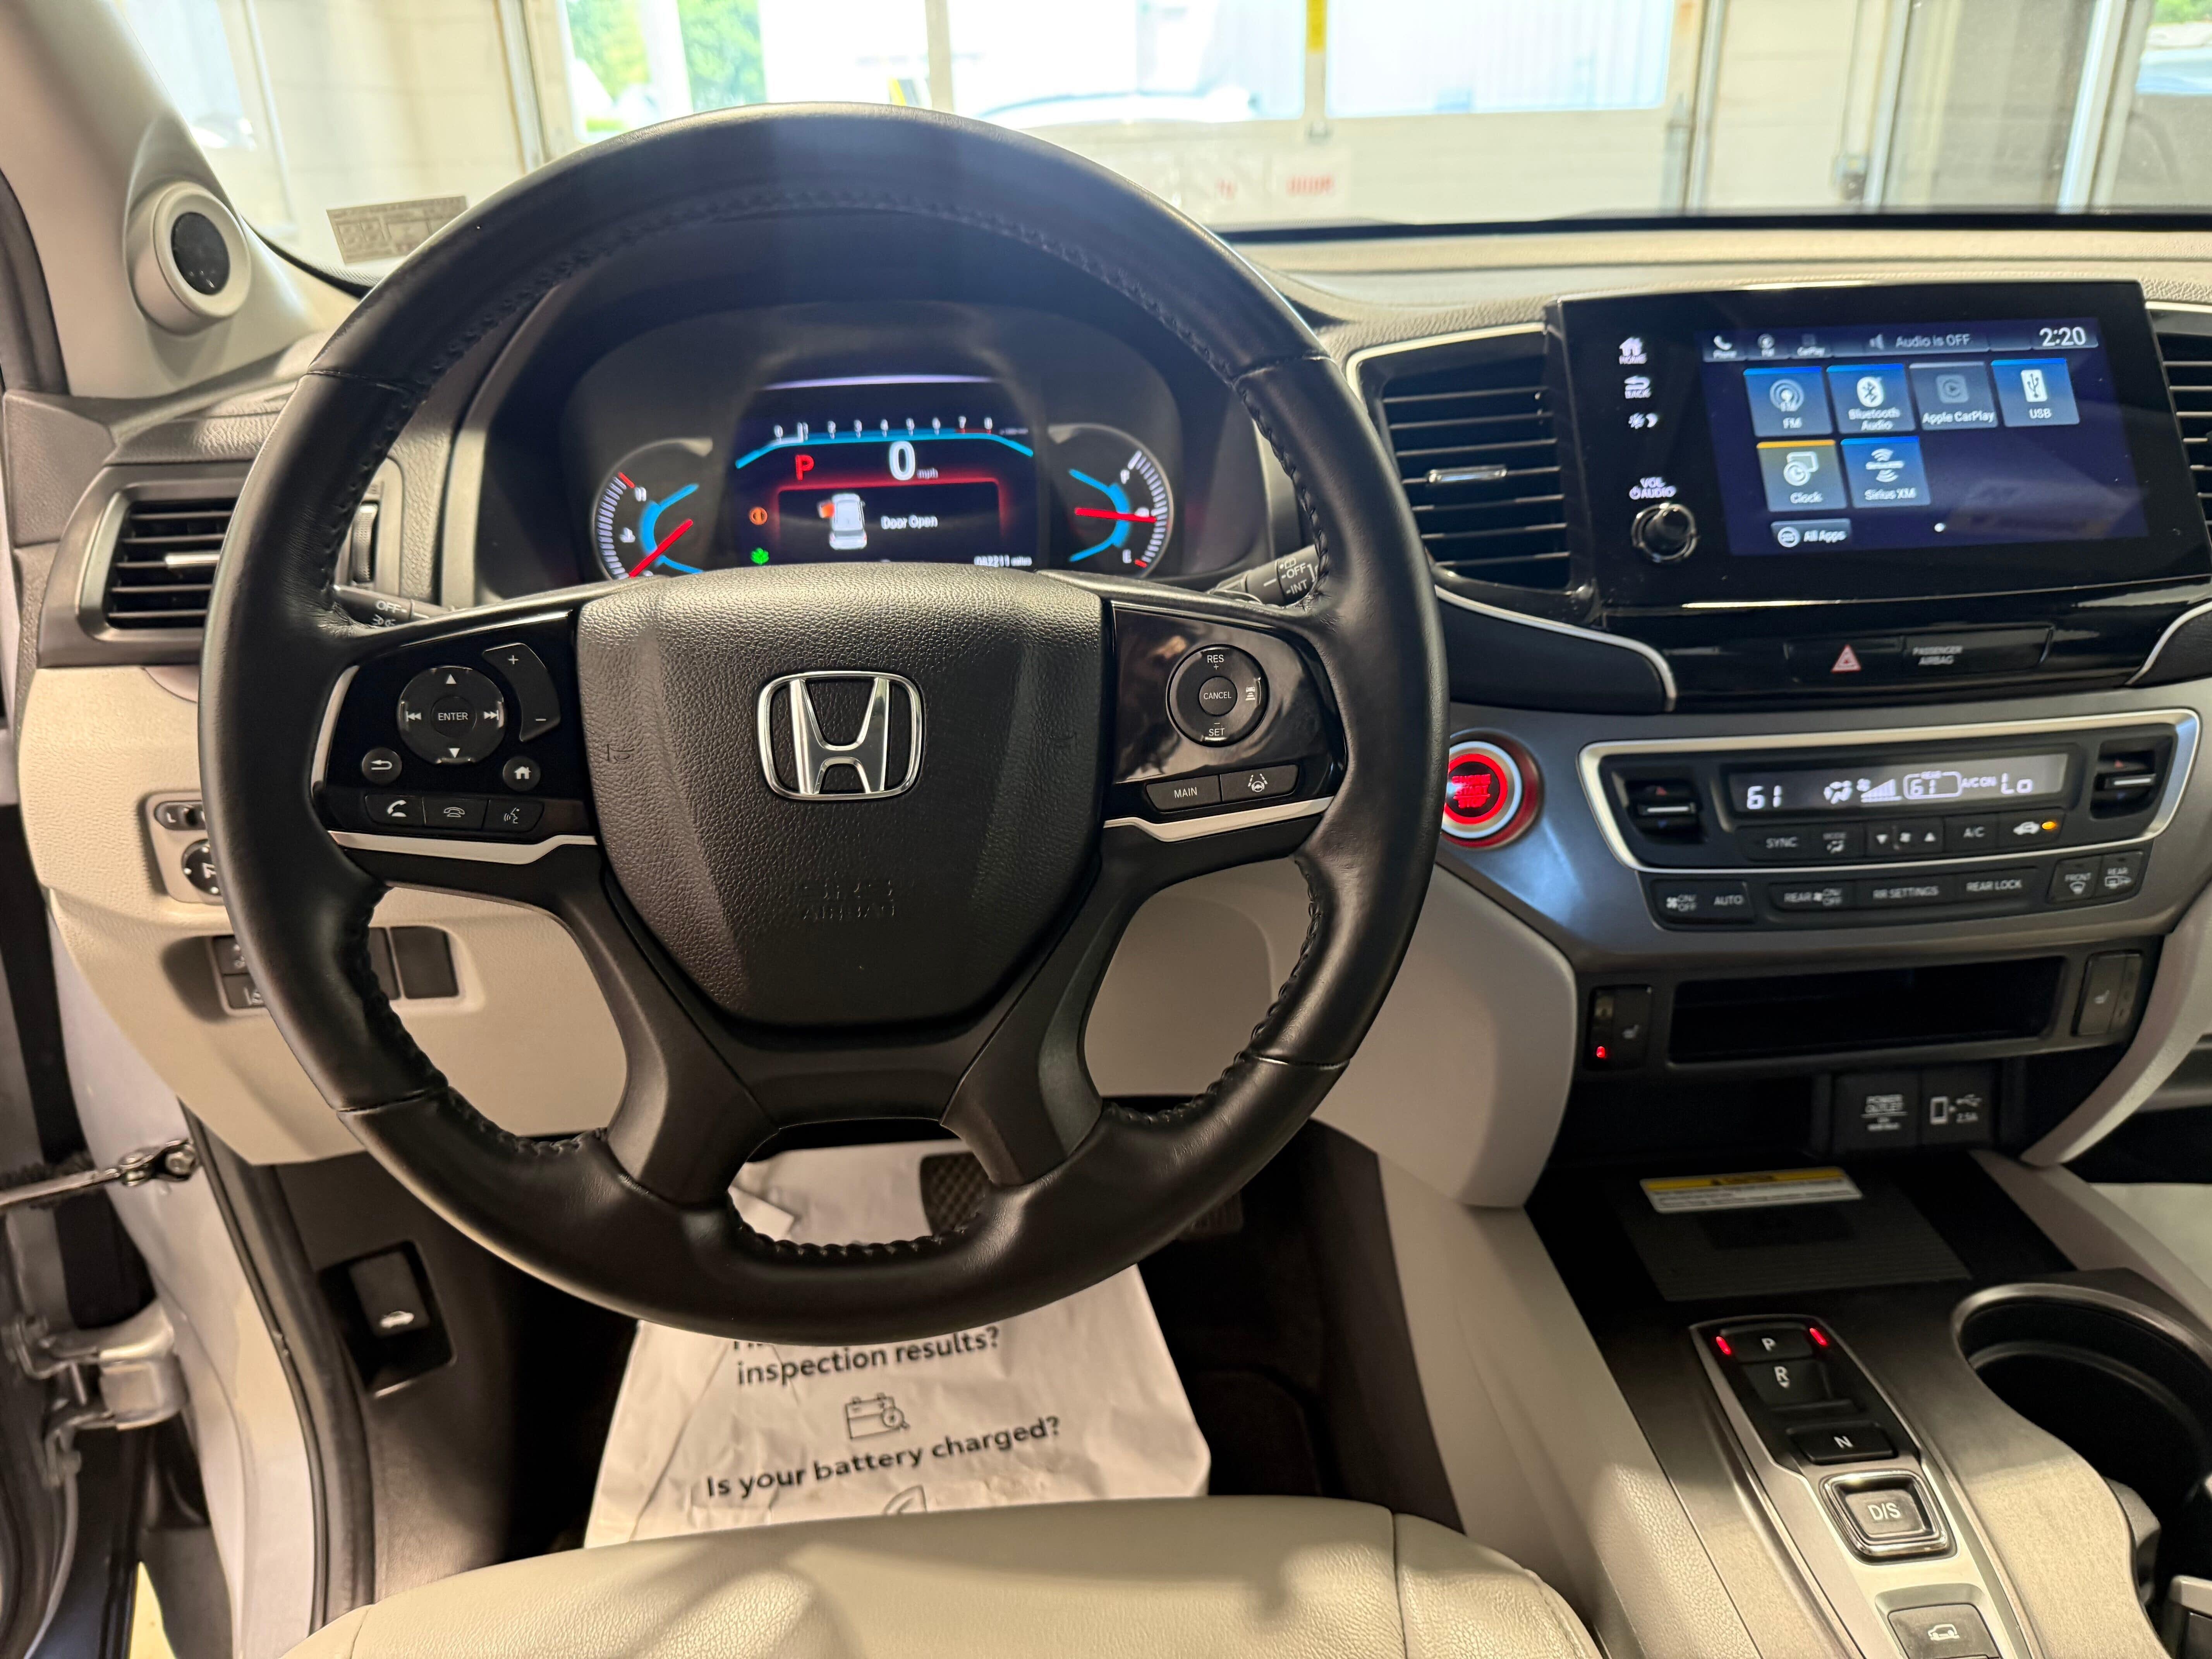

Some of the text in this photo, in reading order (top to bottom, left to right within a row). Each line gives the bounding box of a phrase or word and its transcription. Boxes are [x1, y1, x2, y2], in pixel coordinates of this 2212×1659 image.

[1896, 336, 1932, 347] Audio
[1946, 333, 1971, 346] OFF
[2039, 326, 2087, 347] 2:20
[1848, 407, 1901, 420] Bluetooth
[1922, 411, 1995, 425] Apple CarPlay
[2029, 408, 2052, 419] USB
[1783, 417, 1803, 429] FM
[1861, 419, 1894, 431] Audio
[889, 440, 916, 481] 0
[795, 454, 814, 481] P
[1640, 477, 1666, 488] VOL
[1641, 485, 1677, 499] AUDIO
[1790, 492, 1824, 503] Clock
[1864, 489, 1897, 501] Sirius
[880, 513, 939, 530] Door Open
[1803, 530, 1847, 543] All Apps
[1286, 563, 1306, 579] OFF
[1291, 579, 1307, 595] INT
[375, 600, 401, 613] OFF
[1912, 645, 1963, 656] PASSENGER
[1207, 654, 1224, 663] RES
[1203, 692, 1231, 700] CANCEL
[438, 712, 468, 721] ENTER
[1208, 728, 1225, 736] SET
[2001, 773, 2033, 794] Lo
[1174, 787, 1198, 798] MAIN
[1747, 785, 1782, 809] 61
[1963, 826, 1985, 838] A/C
[1766, 836, 1798, 848] SYNC
[2065, 871, 2091, 882] FRONT
[2107, 867, 2128, 876] REAR
[1966, 878, 2023, 891] REAR LOCK
[1714, 894, 1744, 906] AUTO
[1784, 892, 1813, 902] REAR
[1761, 1337, 1777, 1351] P
[737, 1325, 1001, 1386] inspection results?
[1774, 1365, 1790, 1381] R
[1833, 1436, 1853, 1449] N
[707, 1414, 1061, 1498] Is your battery charged?
[1867, 1503, 1901, 1521] D/S
